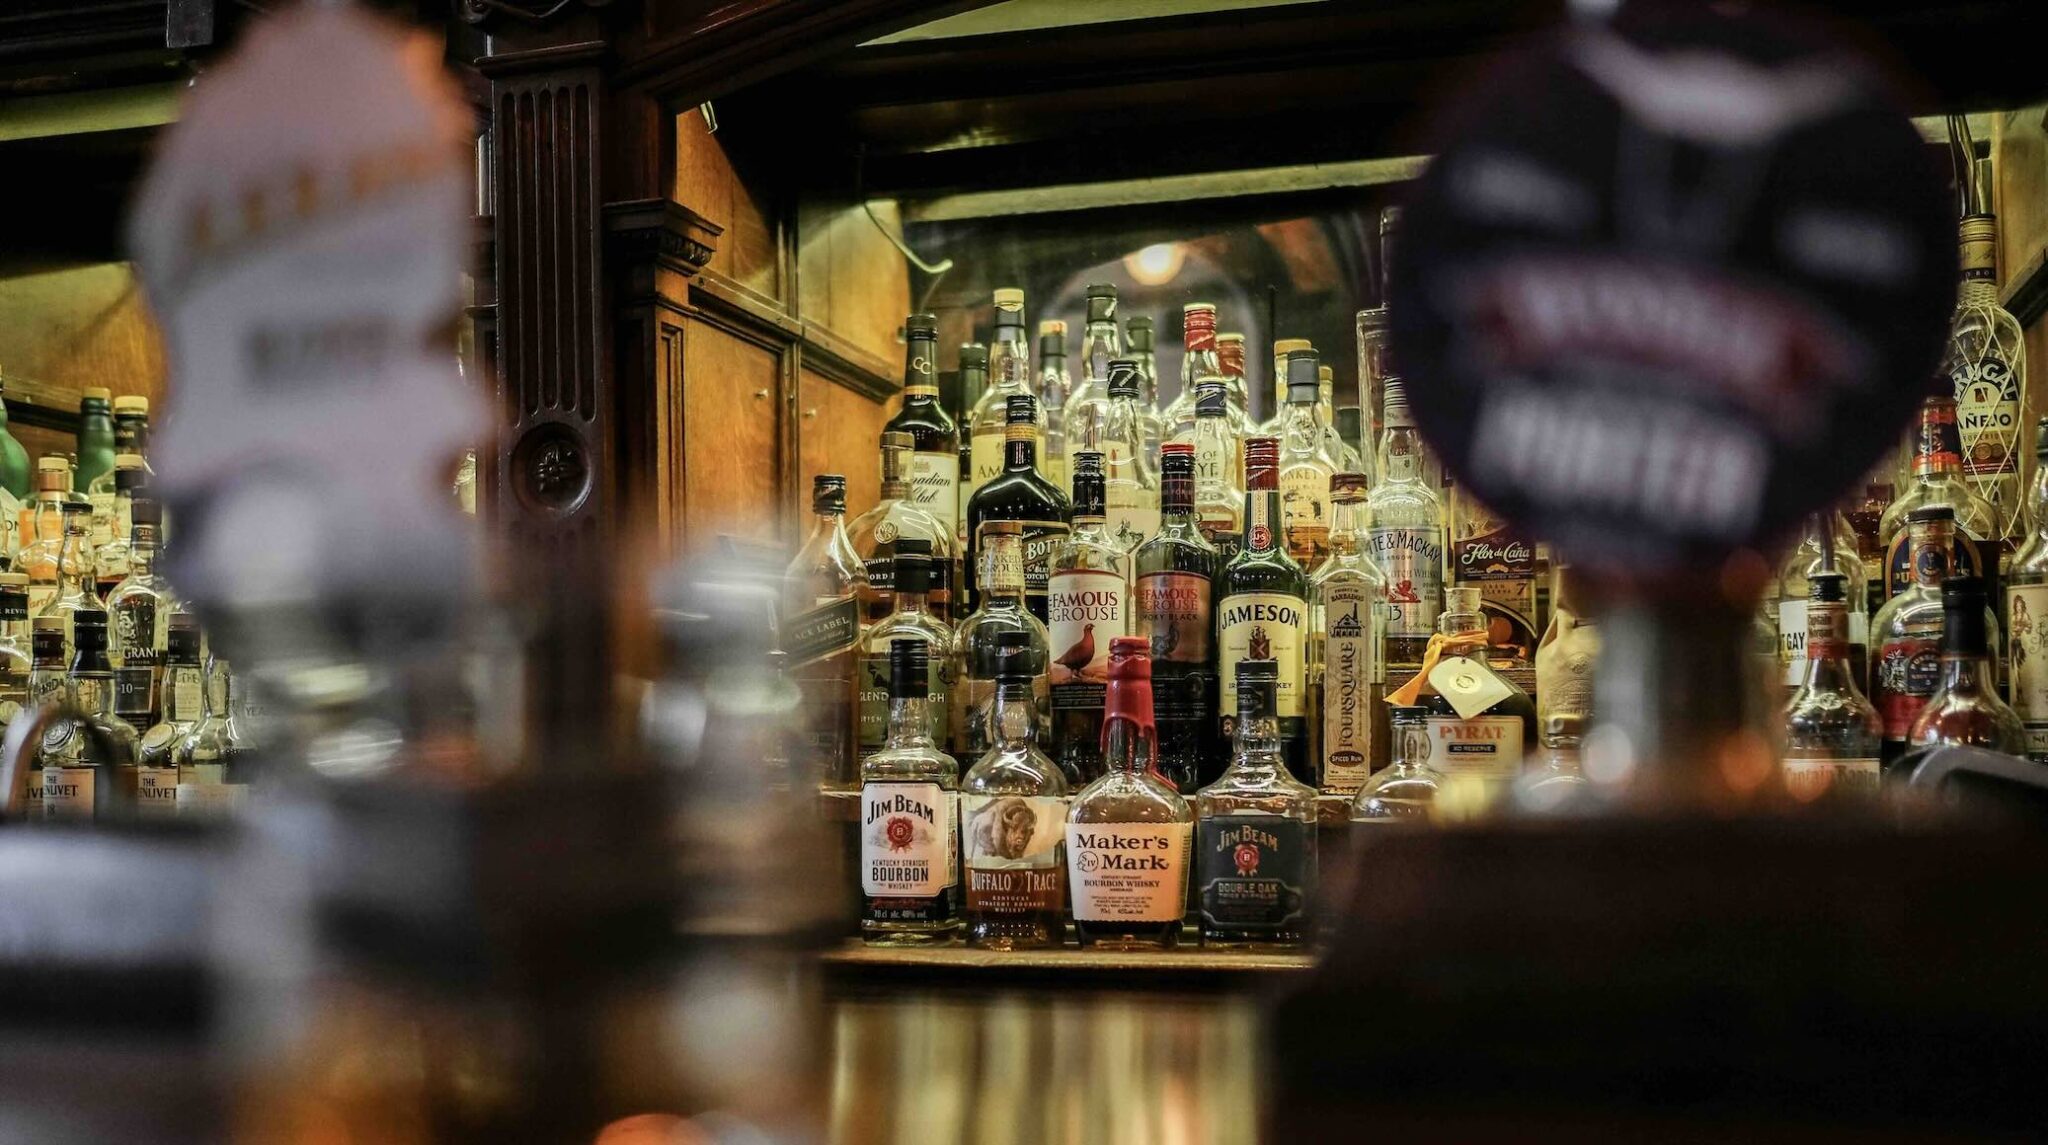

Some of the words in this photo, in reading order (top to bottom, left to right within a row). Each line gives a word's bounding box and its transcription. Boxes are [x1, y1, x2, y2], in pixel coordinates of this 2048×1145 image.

[913, 472, 951, 487] nadian
[1025, 537, 1067, 560] BOTT
[1214, 541, 1239, 556] ar's
[1386, 533, 1395, 549] &
[1396, 531, 1440, 562] MACKAY
[1461, 543, 1494, 565] Flor
[1494, 548, 1504, 557] de
[1503, 541, 1530, 563] Caña
[1052, 591, 1118, 608] FAMOUS
[1144, 588, 1198, 600] FAMOUS
[1144, 600, 1198, 610] GROUSE
[1052, 607, 1118, 622] GROUSE
[1221, 604, 1301, 630] JAMESON
[1388, 605, 1402, 621] 13
[815, 616, 850, 633] LABEL
[123, 647, 160, 660] GRANT
[121, 683, 134, 694] 10
[1440, 725, 1504, 739] PYRAT
[46, 775, 57, 784] THE
[142, 778, 156, 787] THE
[43, 785, 79, 798] NLIVET
[867, 800, 891, 825] JIM
[895, 794, 934, 824] BEAM
[1076, 833, 1169, 850] Maker's
[1216, 829, 1240, 852] JIM
[1242, 824, 1278, 852] BEAM
[1101, 854, 1169, 870] Mark
[872, 867, 929, 882] BOURBON
[970, 869, 1012, 891] BUFFALO
[1025, 871, 1056, 893] TRACE
[888, 882, 913, 890] WHISKEY
[1218, 882, 1255, 893] DOUBLE
[1257, 882, 1278, 893] OAK
